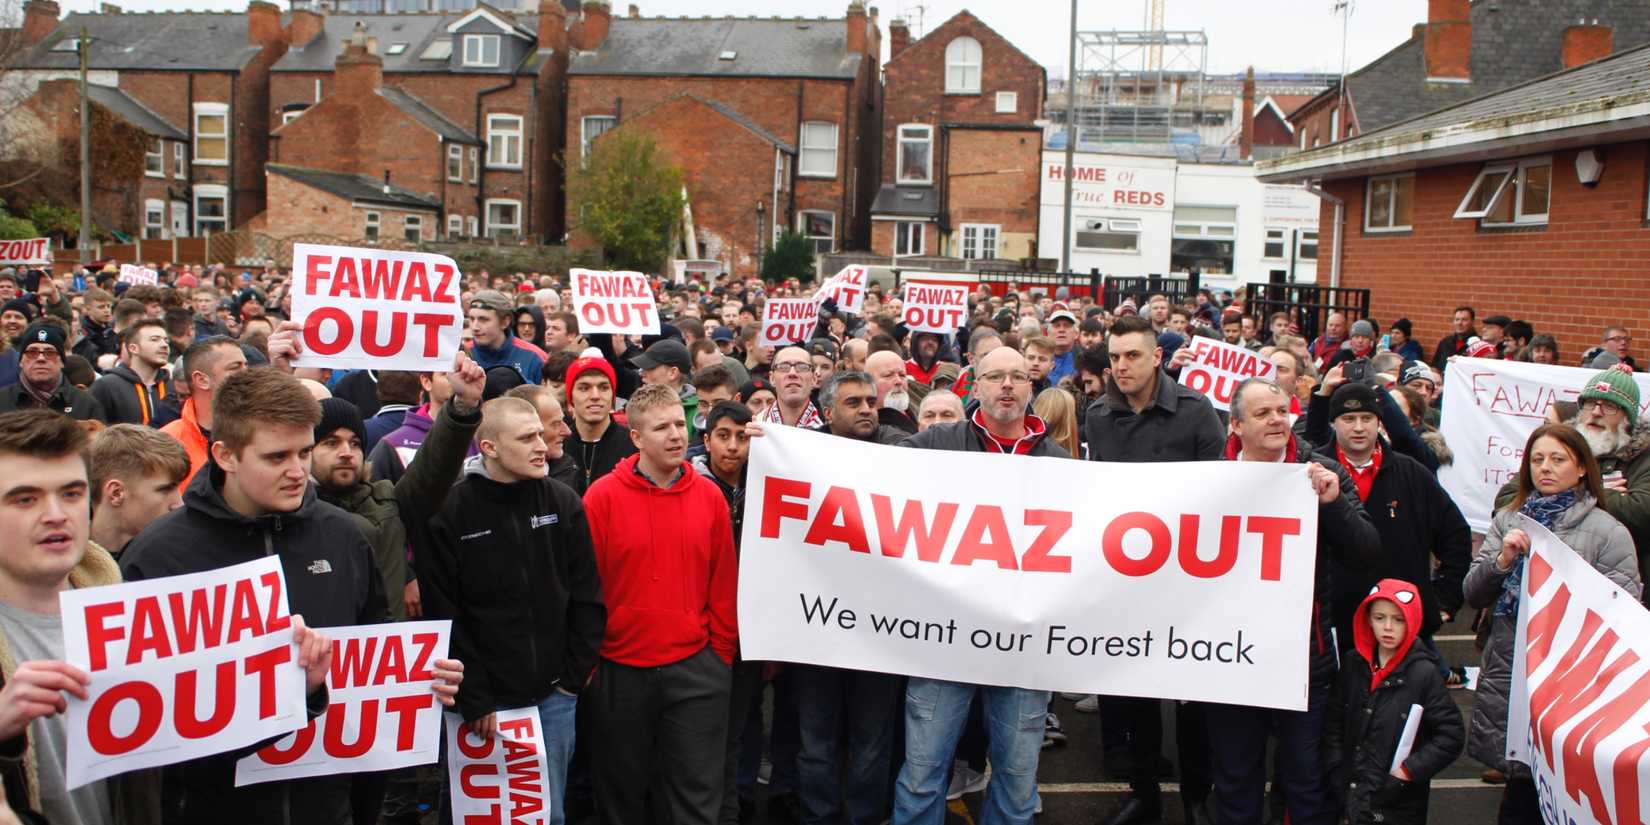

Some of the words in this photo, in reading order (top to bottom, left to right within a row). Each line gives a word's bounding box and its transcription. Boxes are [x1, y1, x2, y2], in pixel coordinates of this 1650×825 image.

[1072, 188, 1104, 203] rue
[1114, 190, 1165, 206] REDS
[306, 255, 455, 303] FAWAZ
[577, 274, 649, 297] FAWAZ
[908, 287, 964, 305] FAWAZ
[303, 306, 455, 358] OUT
[581, 302, 651, 327] OUT
[766, 322, 816, 342] OUT
[905, 307, 963, 328] OUT
[1185, 369, 1239, 404] OU
[759, 475, 1072, 574] FAWAZ
[1102, 511, 1302, 581] OUT
[84, 571, 291, 672] FAWAZ
[800, 593, 857, 629] We
[871, 613, 957, 645] want
[971, 628, 1032, 652] our
[1046, 626, 1153, 657] Forest
[1168, 627, 1254, 664] back
[331, 633, 439, 690] WAZ
[87, 644, 291, 756] OUT
